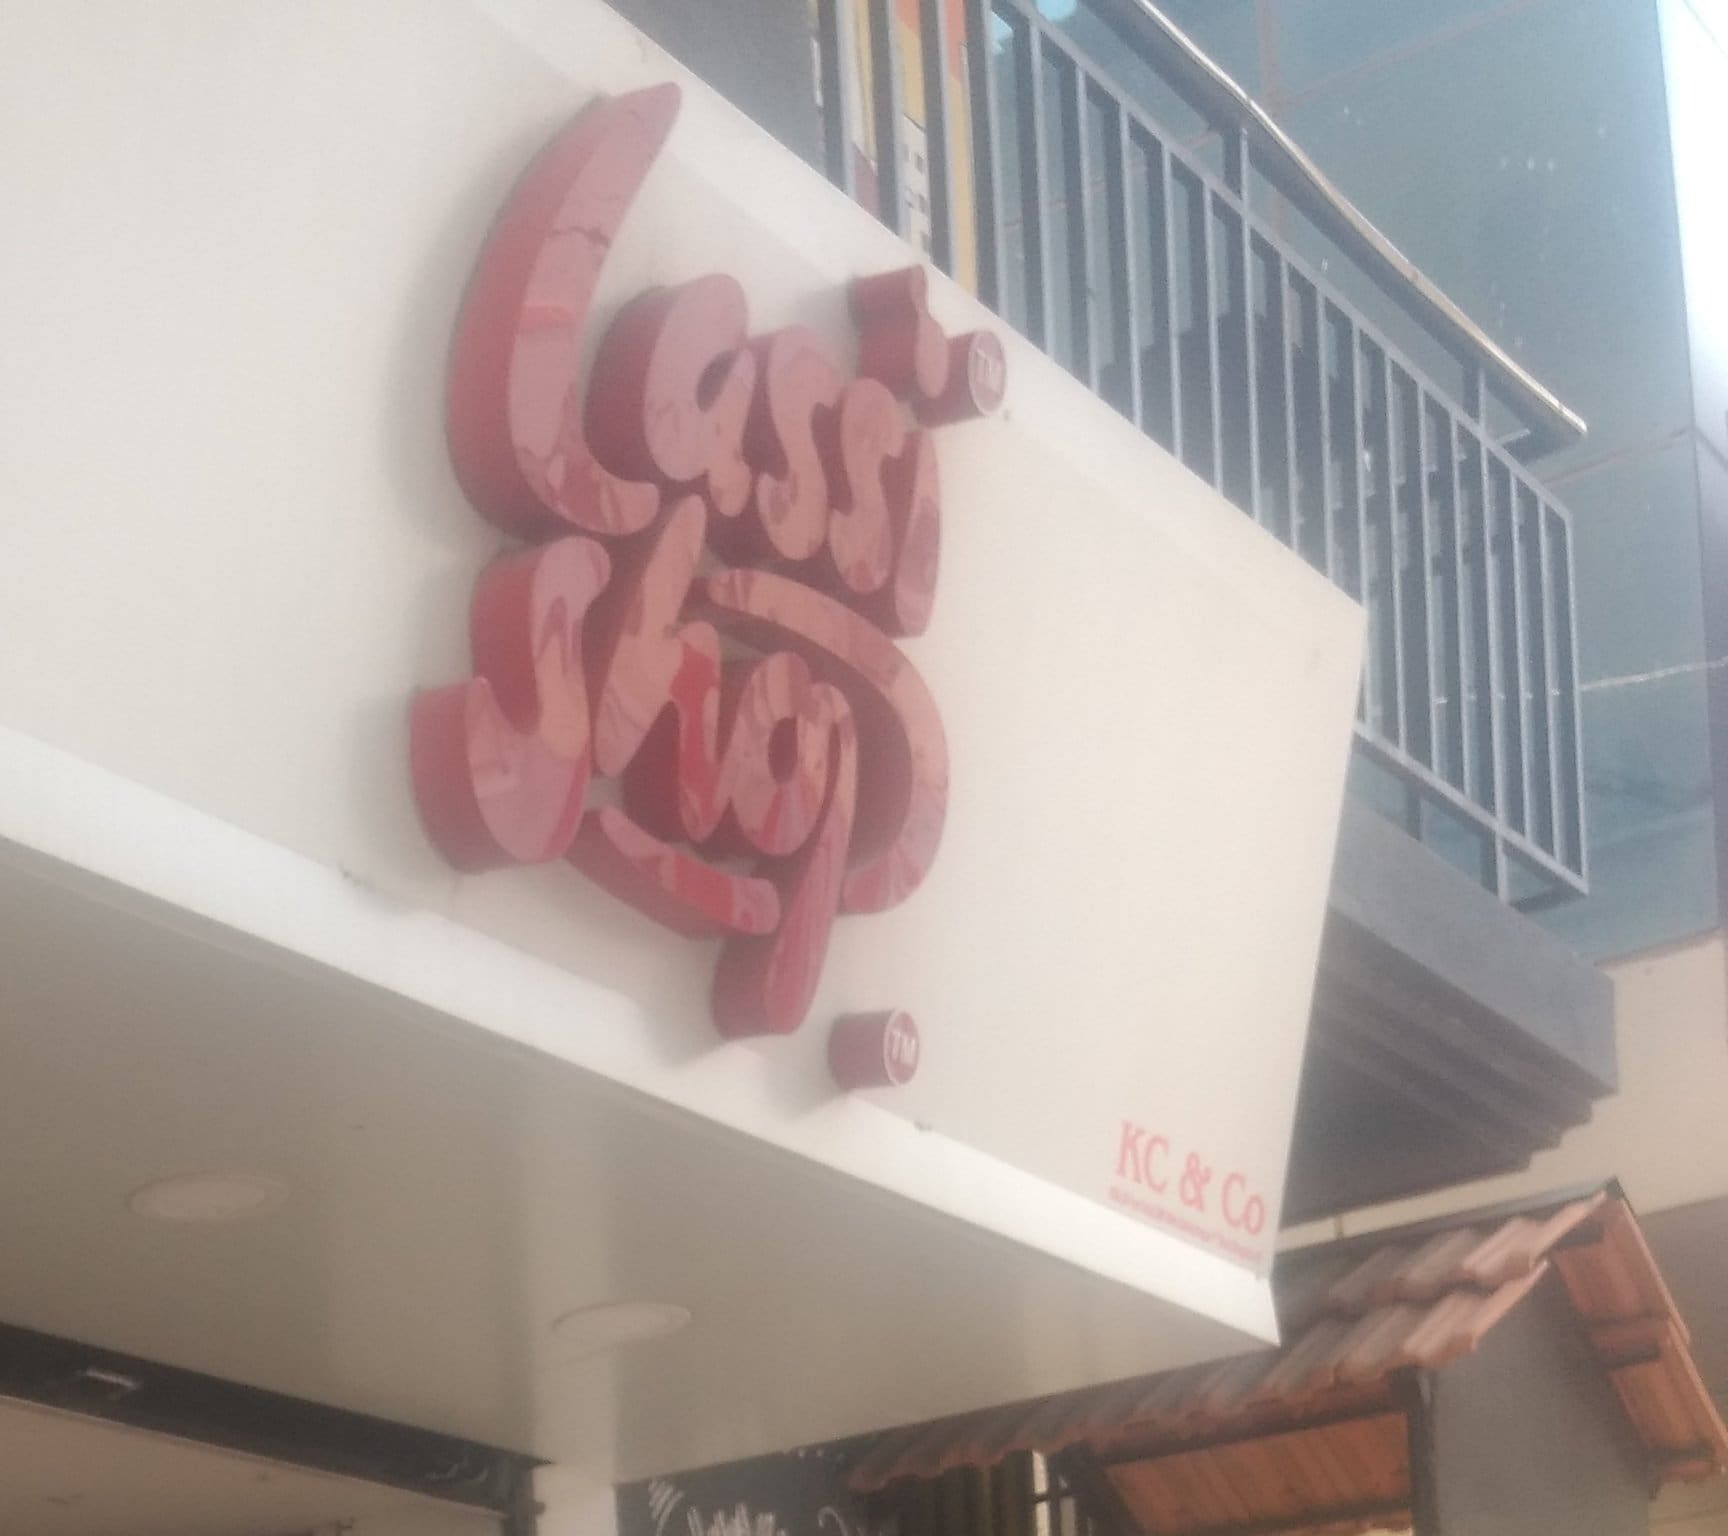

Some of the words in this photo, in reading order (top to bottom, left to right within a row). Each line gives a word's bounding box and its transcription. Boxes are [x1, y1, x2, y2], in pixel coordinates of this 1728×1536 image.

[446, 82, 948, 640] Lassi
[1116, 1118, 1170, 1195] KC
[1178, 1151, 1213, 1213] &
[1222, 1171, 1266, 1236] Co
